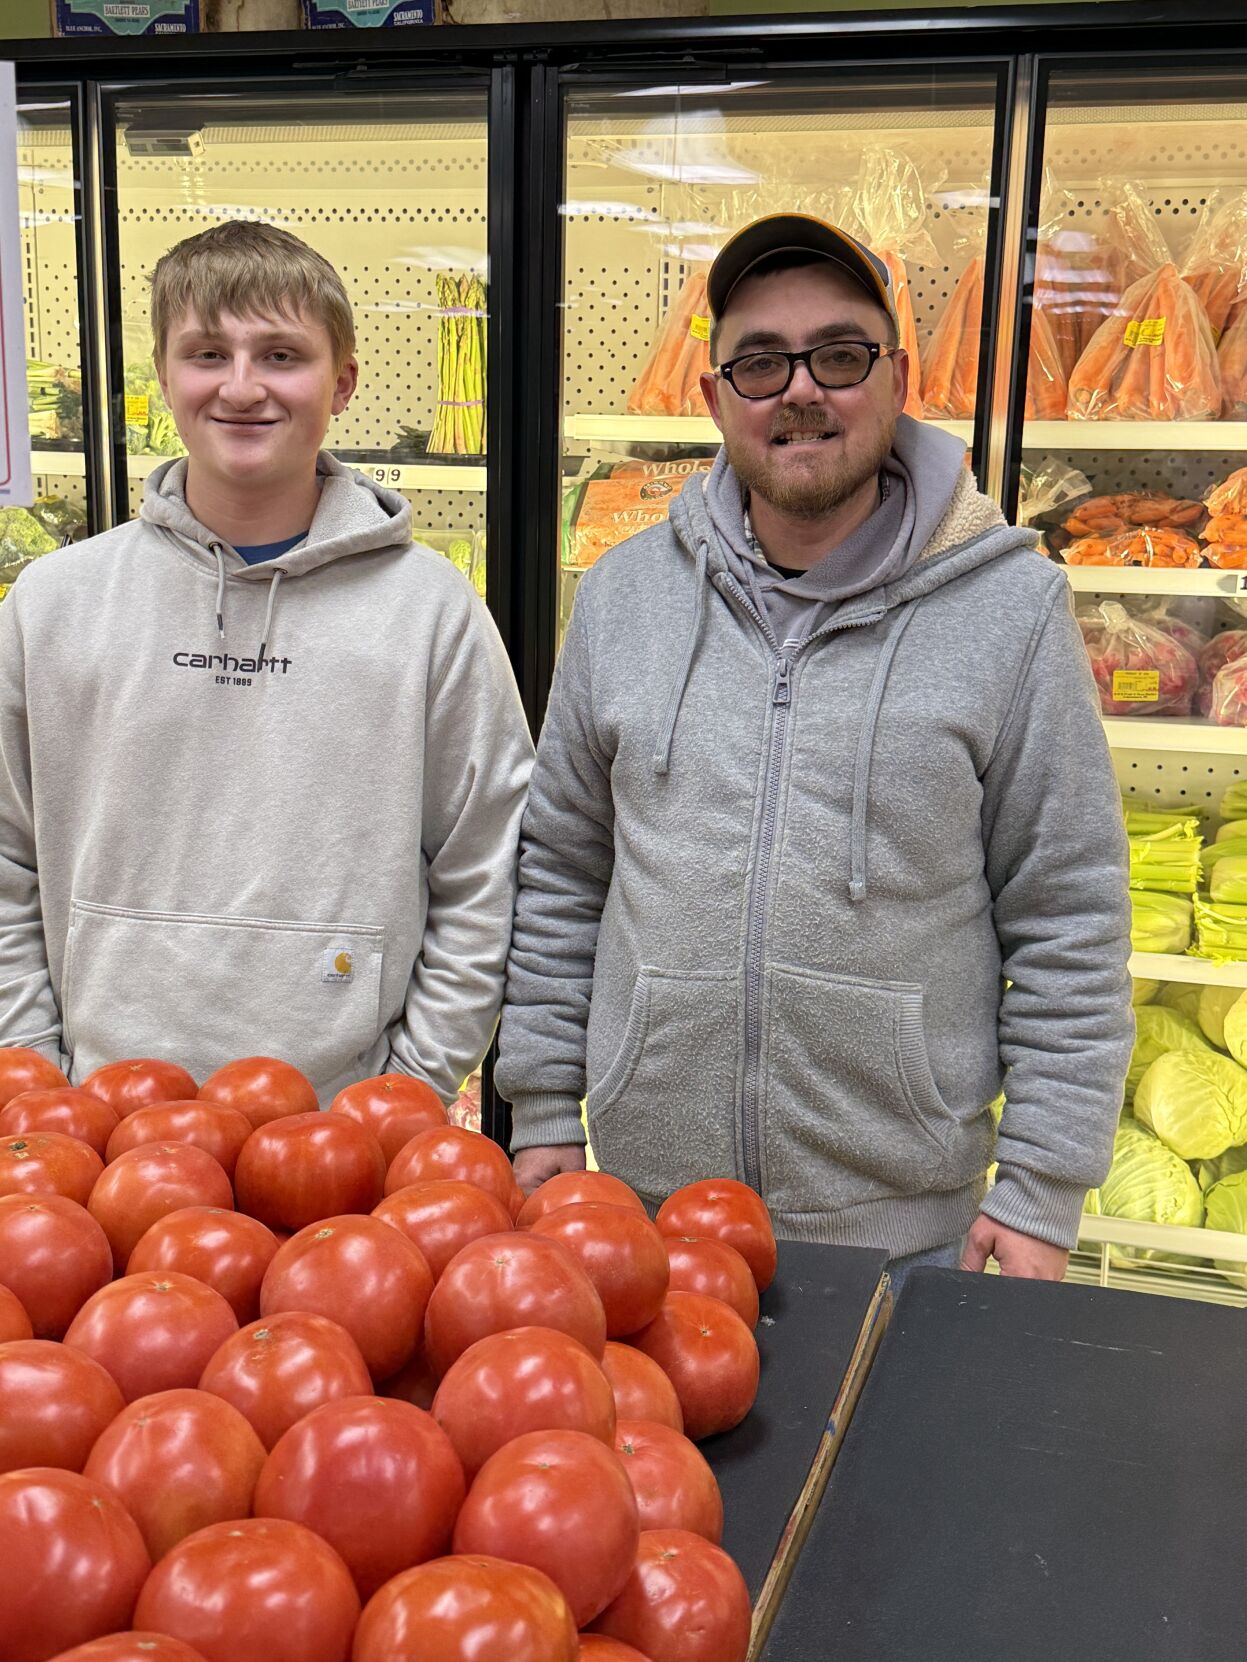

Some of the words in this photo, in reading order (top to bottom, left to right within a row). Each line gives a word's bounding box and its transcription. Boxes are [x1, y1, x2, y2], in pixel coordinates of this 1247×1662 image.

[105, 6, 130, 15] BARTLETT
[131, 6, 149, 16] PEARS
[393, 9, 423, 21] SACRAMENTO
[154, 23, 187, 32] SACRAMENTO
[612, 510, 669, 523] Who
[173, 652, 293, 674] carhartt
[215, 676, 230, 685] EST
[233, 677, 252, 686] 1889
